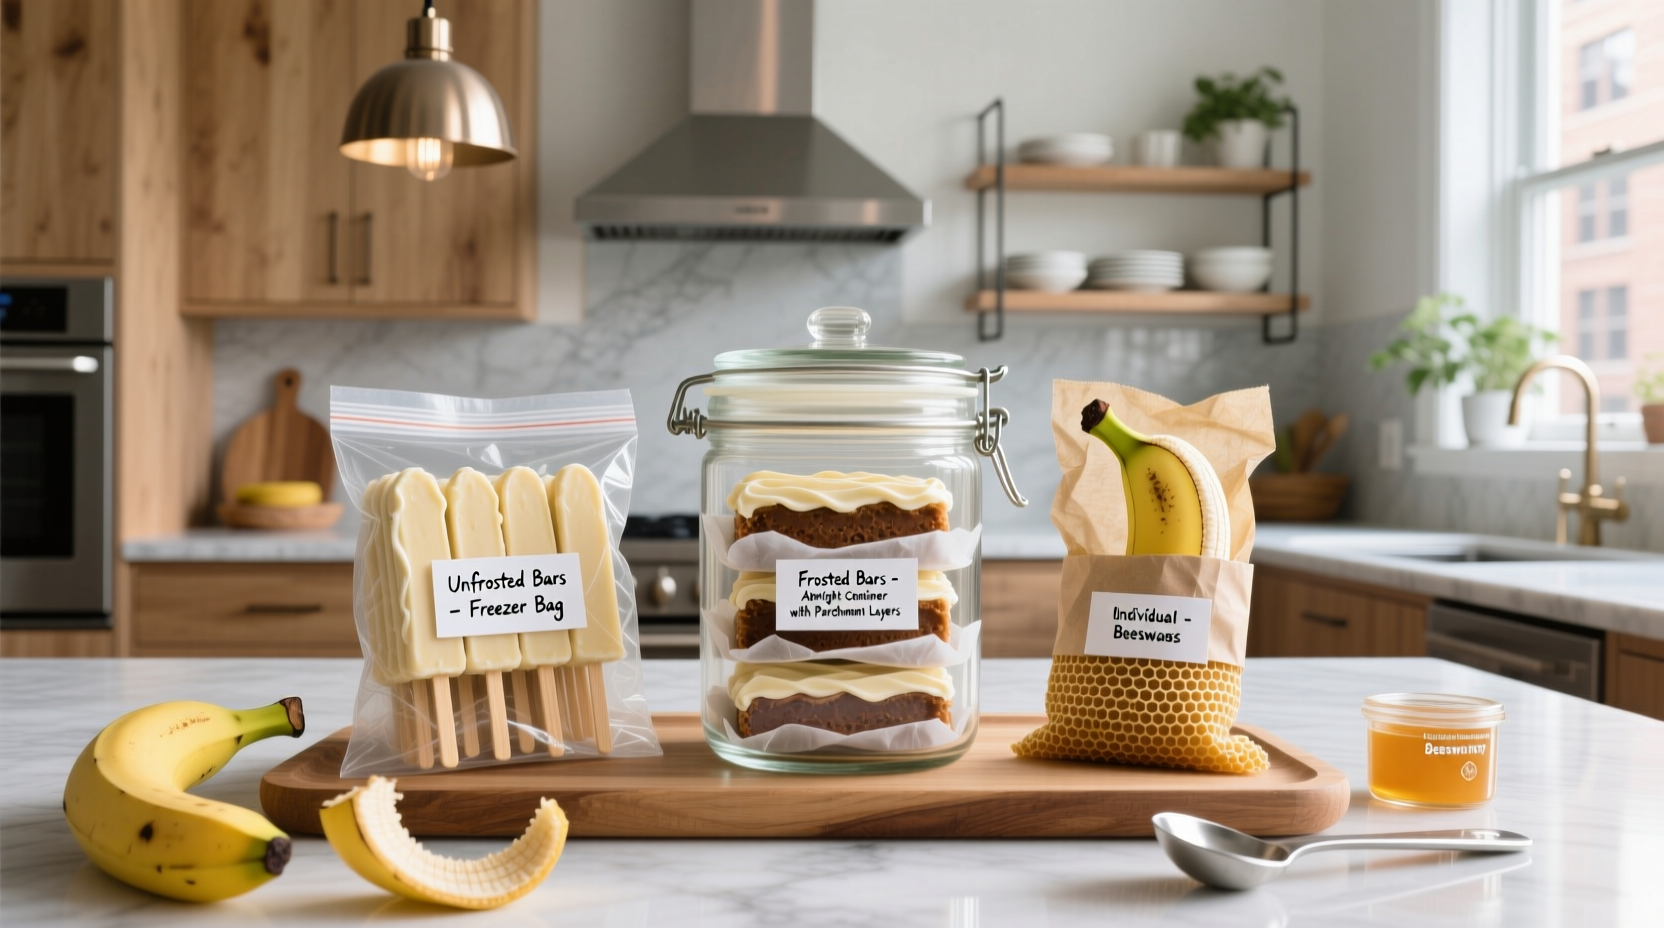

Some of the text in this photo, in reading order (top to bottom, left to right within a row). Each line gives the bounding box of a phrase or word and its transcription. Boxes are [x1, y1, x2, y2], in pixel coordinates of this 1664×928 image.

[448, 568, 567, 593] Unfrosted Bars
[798, 569, 850, 588] Frosted
[856, 569, 887, 586] Bars
[469, 598, 527, 618] Freezer
[534, 595, 564, 622] Bag
[869, 605, 901, 622] Layers
